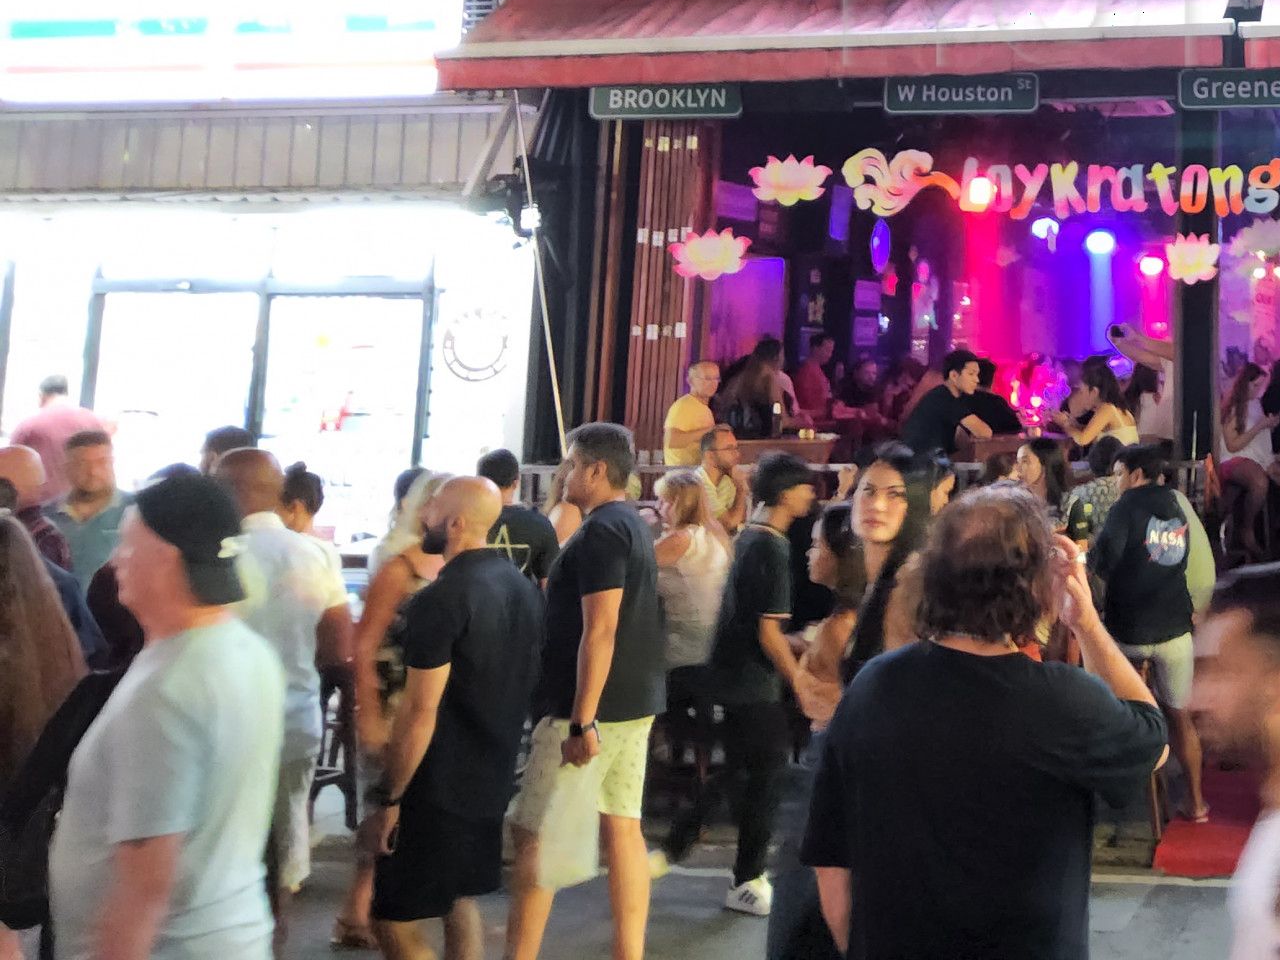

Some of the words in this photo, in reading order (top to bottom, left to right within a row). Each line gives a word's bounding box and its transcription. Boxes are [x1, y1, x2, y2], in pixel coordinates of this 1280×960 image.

[608, 88, 727, 109] BROOKLYN
[897, 84, 916, 102] W
[922, 83, 1013, 102] Houston
[1016, 77, 1032, 89] St
[1148, 528, 1187, 549] NASA
